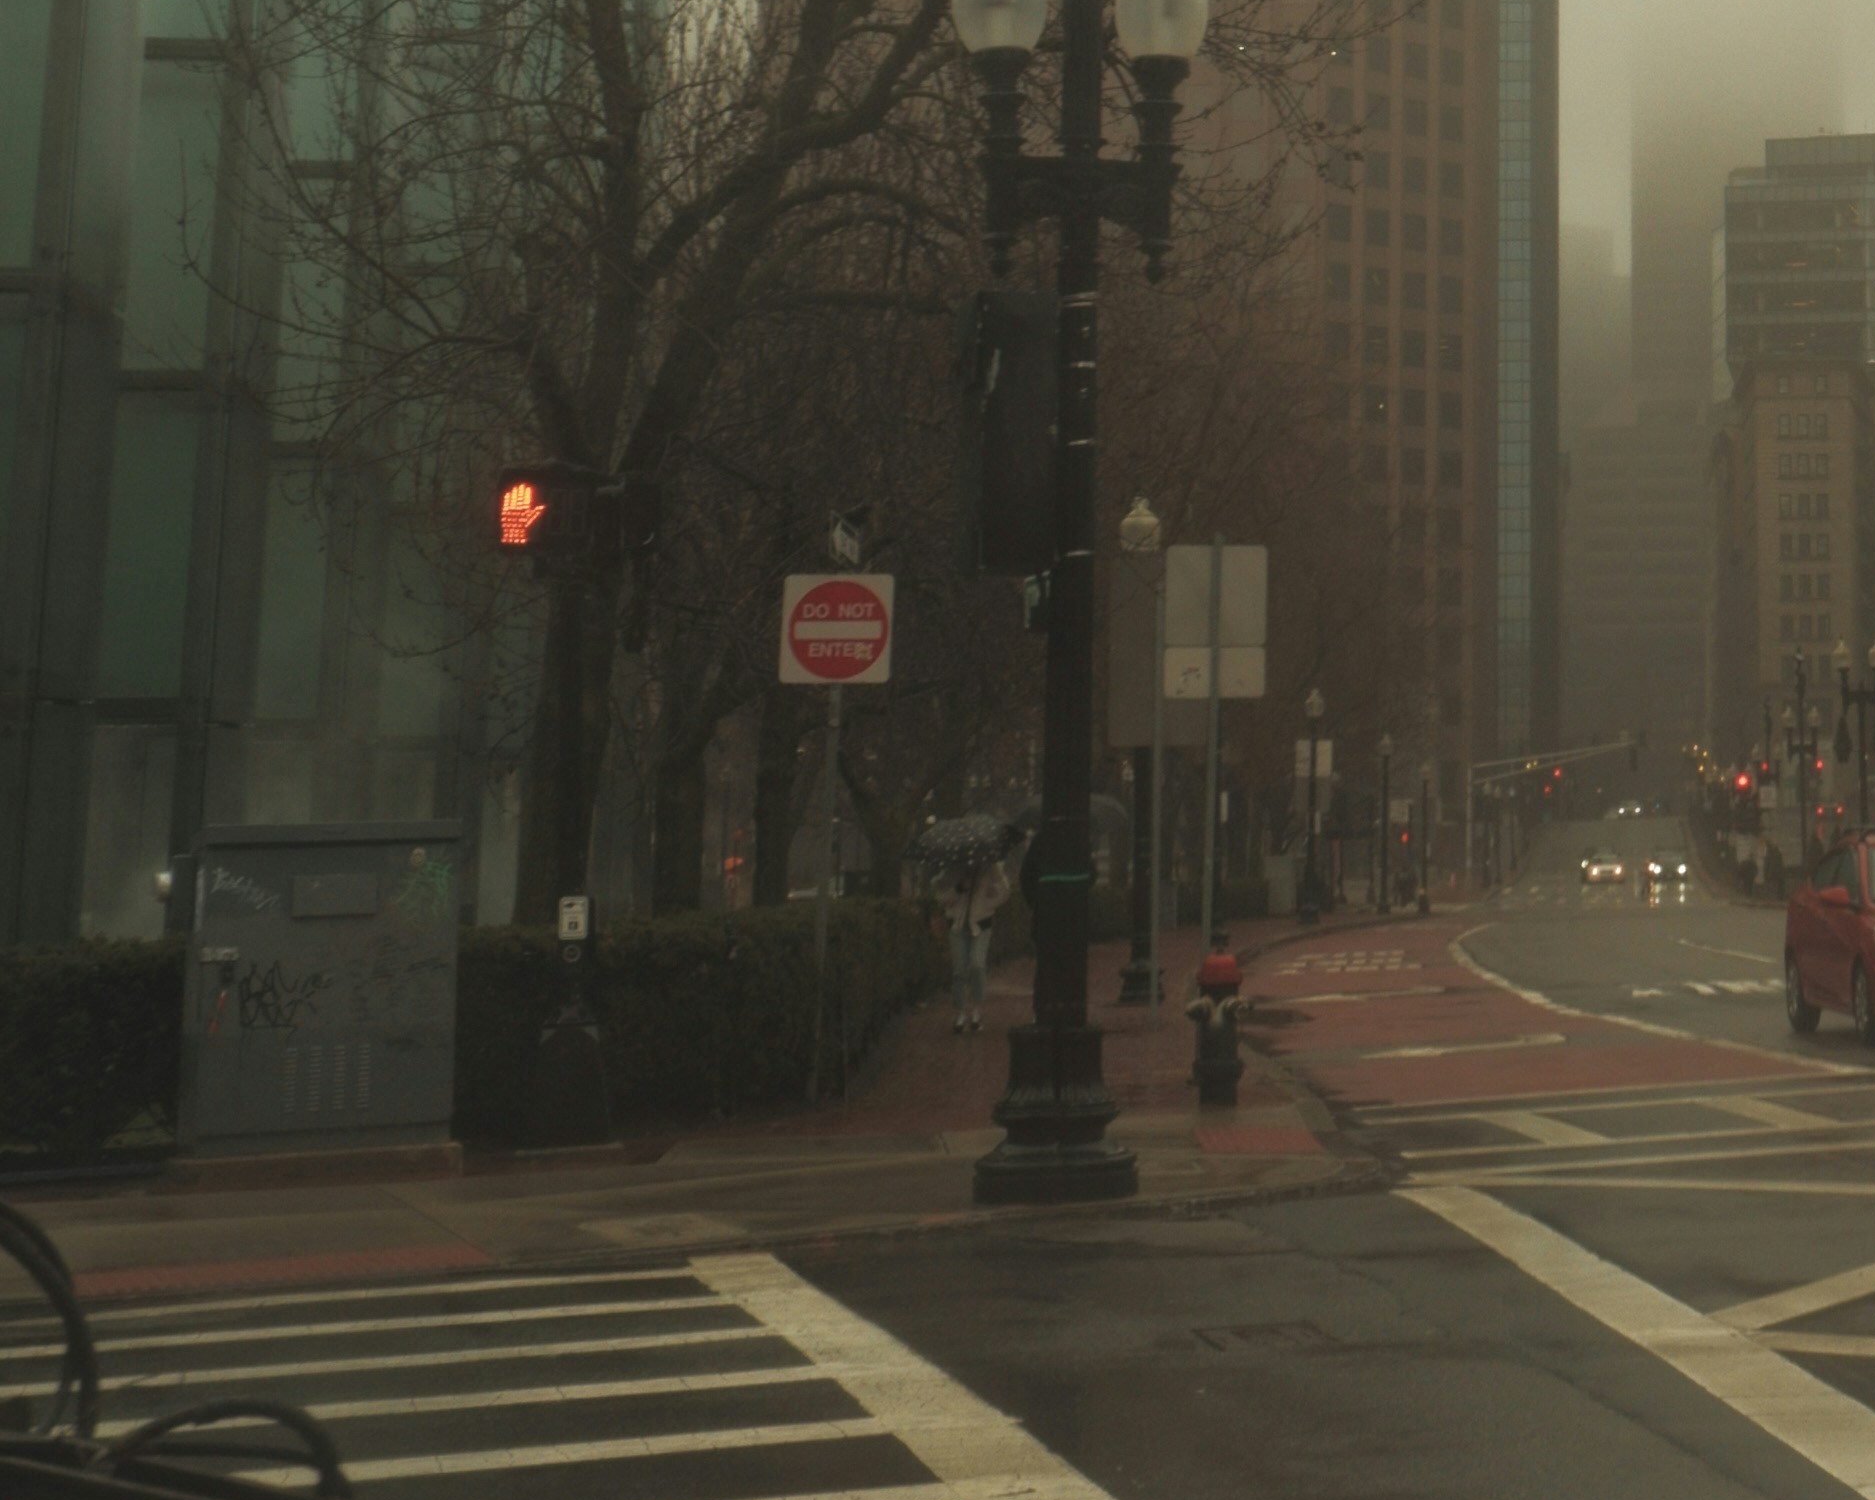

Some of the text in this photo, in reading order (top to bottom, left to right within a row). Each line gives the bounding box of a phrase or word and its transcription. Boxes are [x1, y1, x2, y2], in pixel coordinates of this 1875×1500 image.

[802, 602, 876, 618] DO NOT
[807, 642, 872, 659] ENTE
